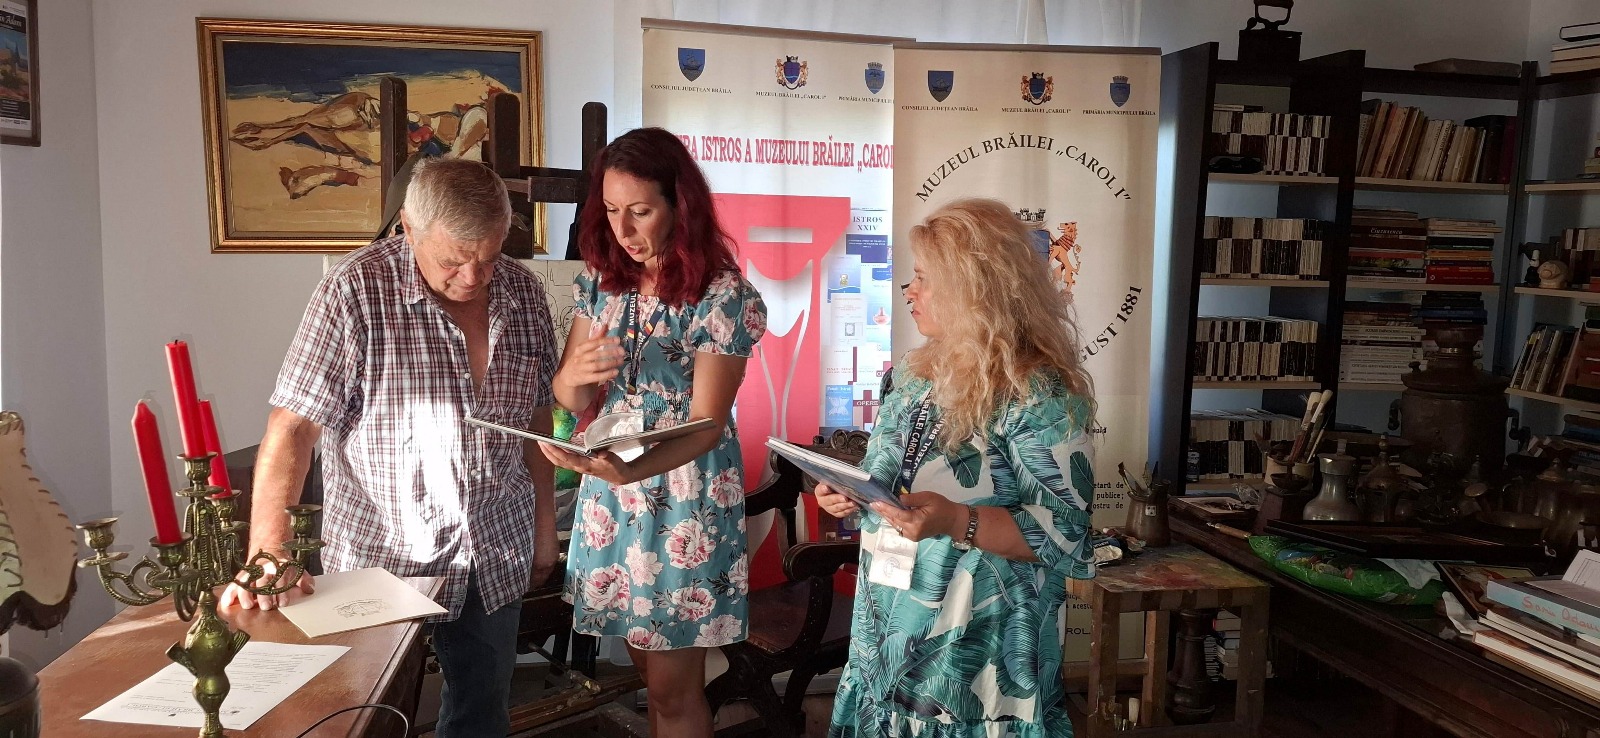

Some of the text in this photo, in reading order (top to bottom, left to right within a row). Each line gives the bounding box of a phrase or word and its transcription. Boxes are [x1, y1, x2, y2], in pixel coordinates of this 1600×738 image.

[701, 135, 742, 162] ISTROS
[745, 138, 752, 163] A
[755, 138, 810, 167] MUZEULUI
[813, 135, 855, 168] BRĂILEI
[915, 143, 981, 203] MUZEUL
[981, 132, 1055, 154] BRĂILEI
[629, 293, 637, 326] MUZEUL
[1115, 286, 1142, 325] 1881
[905, 432, 920, 458] CAROL
[1115, 481, 1124, 489] de
[1065, 627, 1091, 635] ROL.
